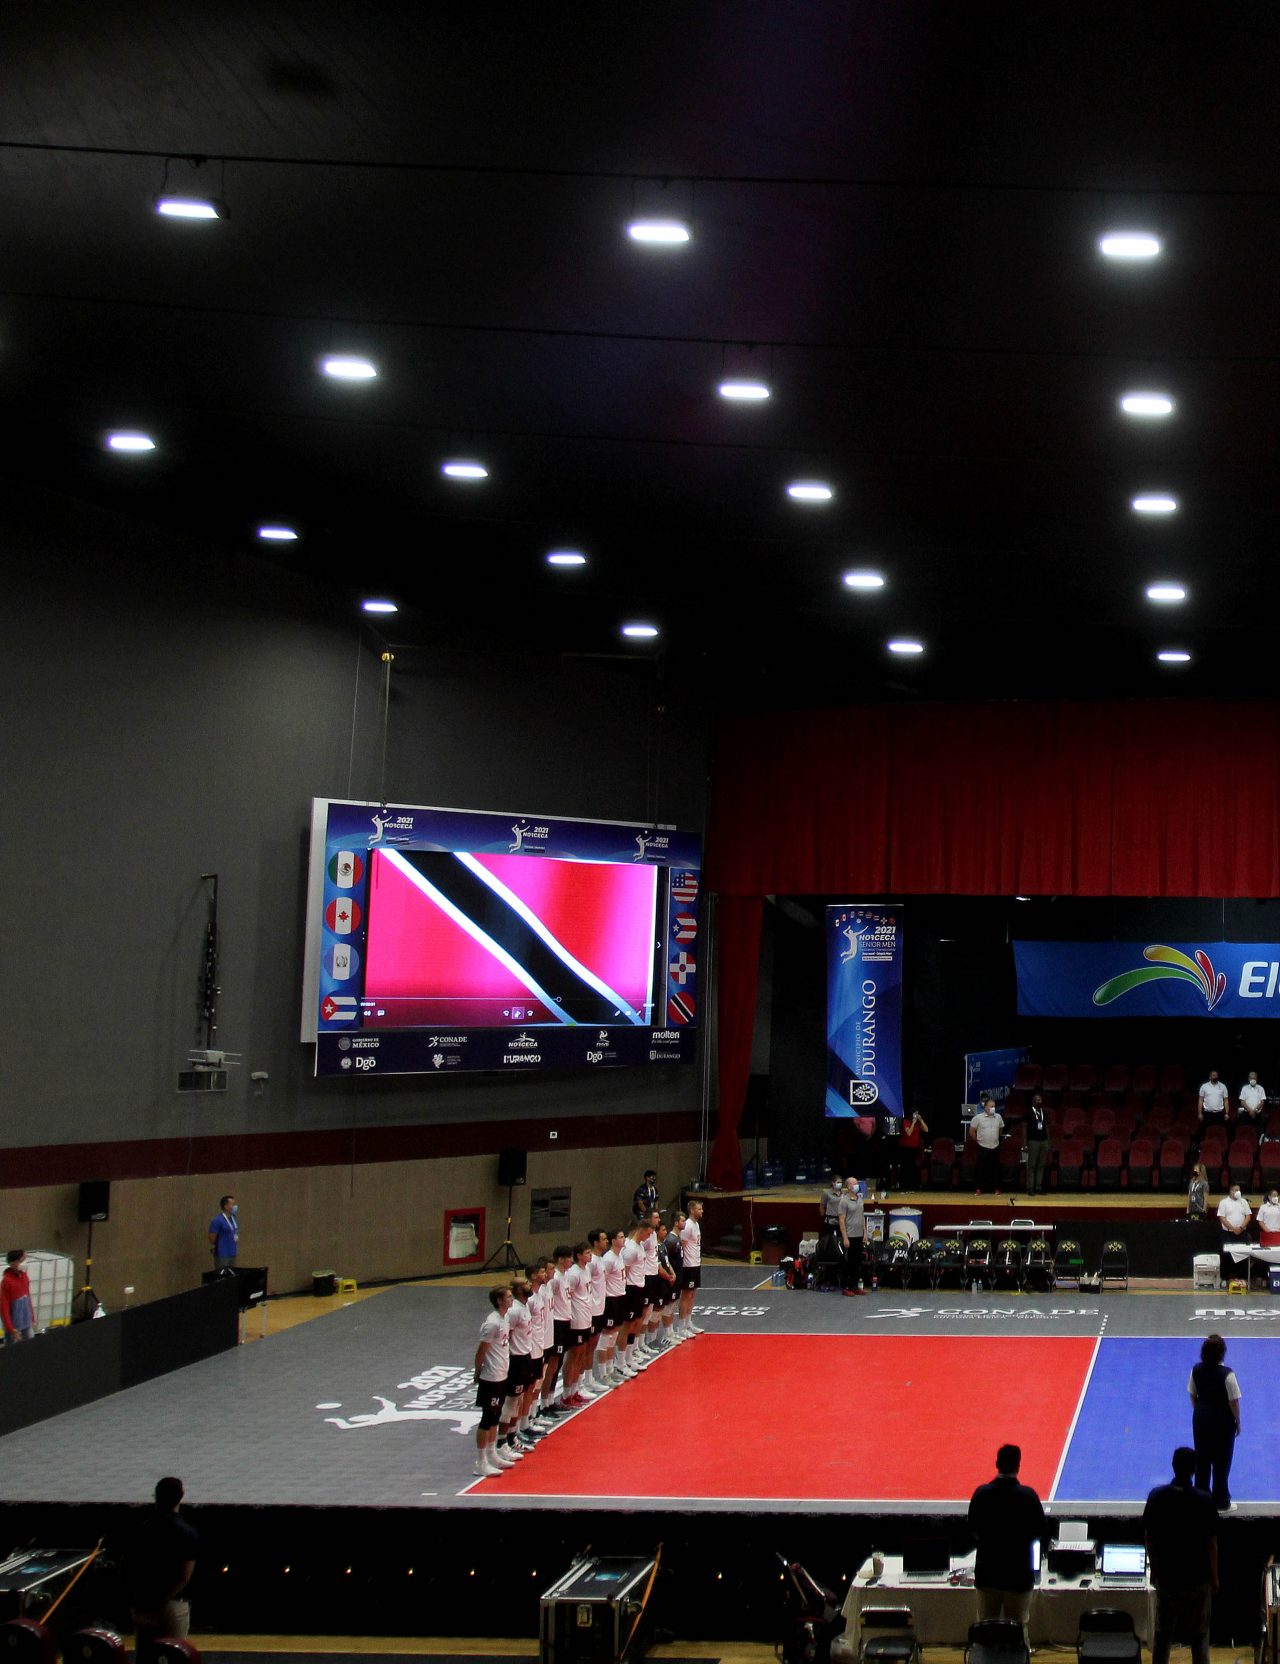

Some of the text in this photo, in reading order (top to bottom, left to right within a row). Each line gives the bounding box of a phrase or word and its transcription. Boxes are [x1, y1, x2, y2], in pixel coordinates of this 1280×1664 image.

[874, 926, 896, 934] 2021
[652, 1030, 680, 1039] molten
[862, 979, 877, 1076] DURANGO
[396, 1365, 465, 1390] 2021
[402, 1367, 475, 1408] NORCEC
[490, 1397, 500, 1406] 24
